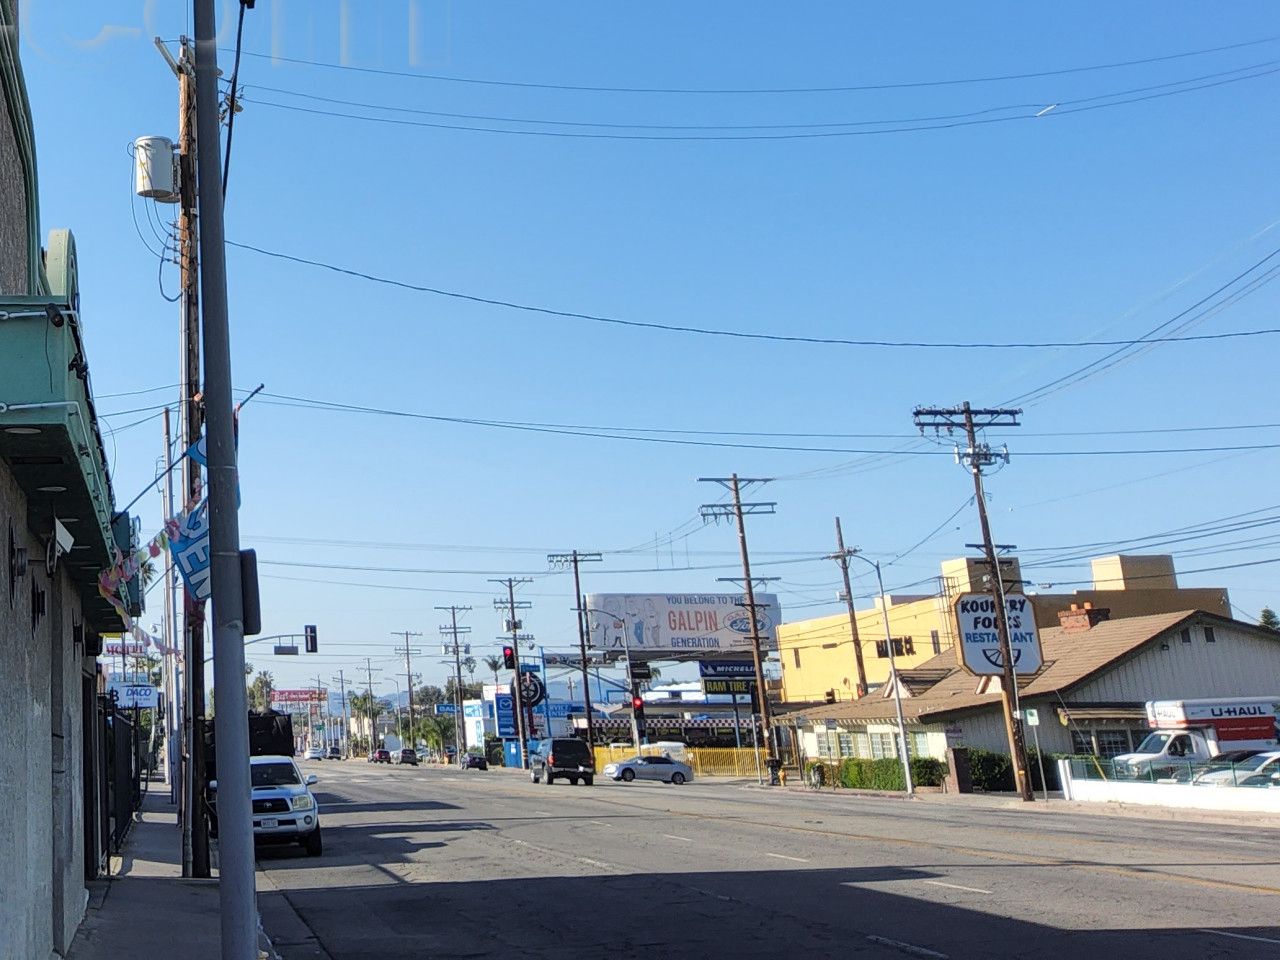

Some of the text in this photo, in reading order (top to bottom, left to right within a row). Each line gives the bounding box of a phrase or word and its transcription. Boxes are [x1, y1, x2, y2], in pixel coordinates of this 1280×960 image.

[666, 596, 683, 605] YOU
[685, 596, 716, 605] BELONG
[718, 596, 728, 605] TO
[961, 599, 1026, 614] KOURY
[668, 610, 718, 631] GALPIN
[671, 637, 720, 648] GENERATION
[965, 632, 1034, 643] RESTAANT
[707, 681, 726, 691] RAM
[730, 680, 748, 691] TIRE
[126, 688, 152, 696] DACO
[1211, 706, 1267, 717] U-HAUL
